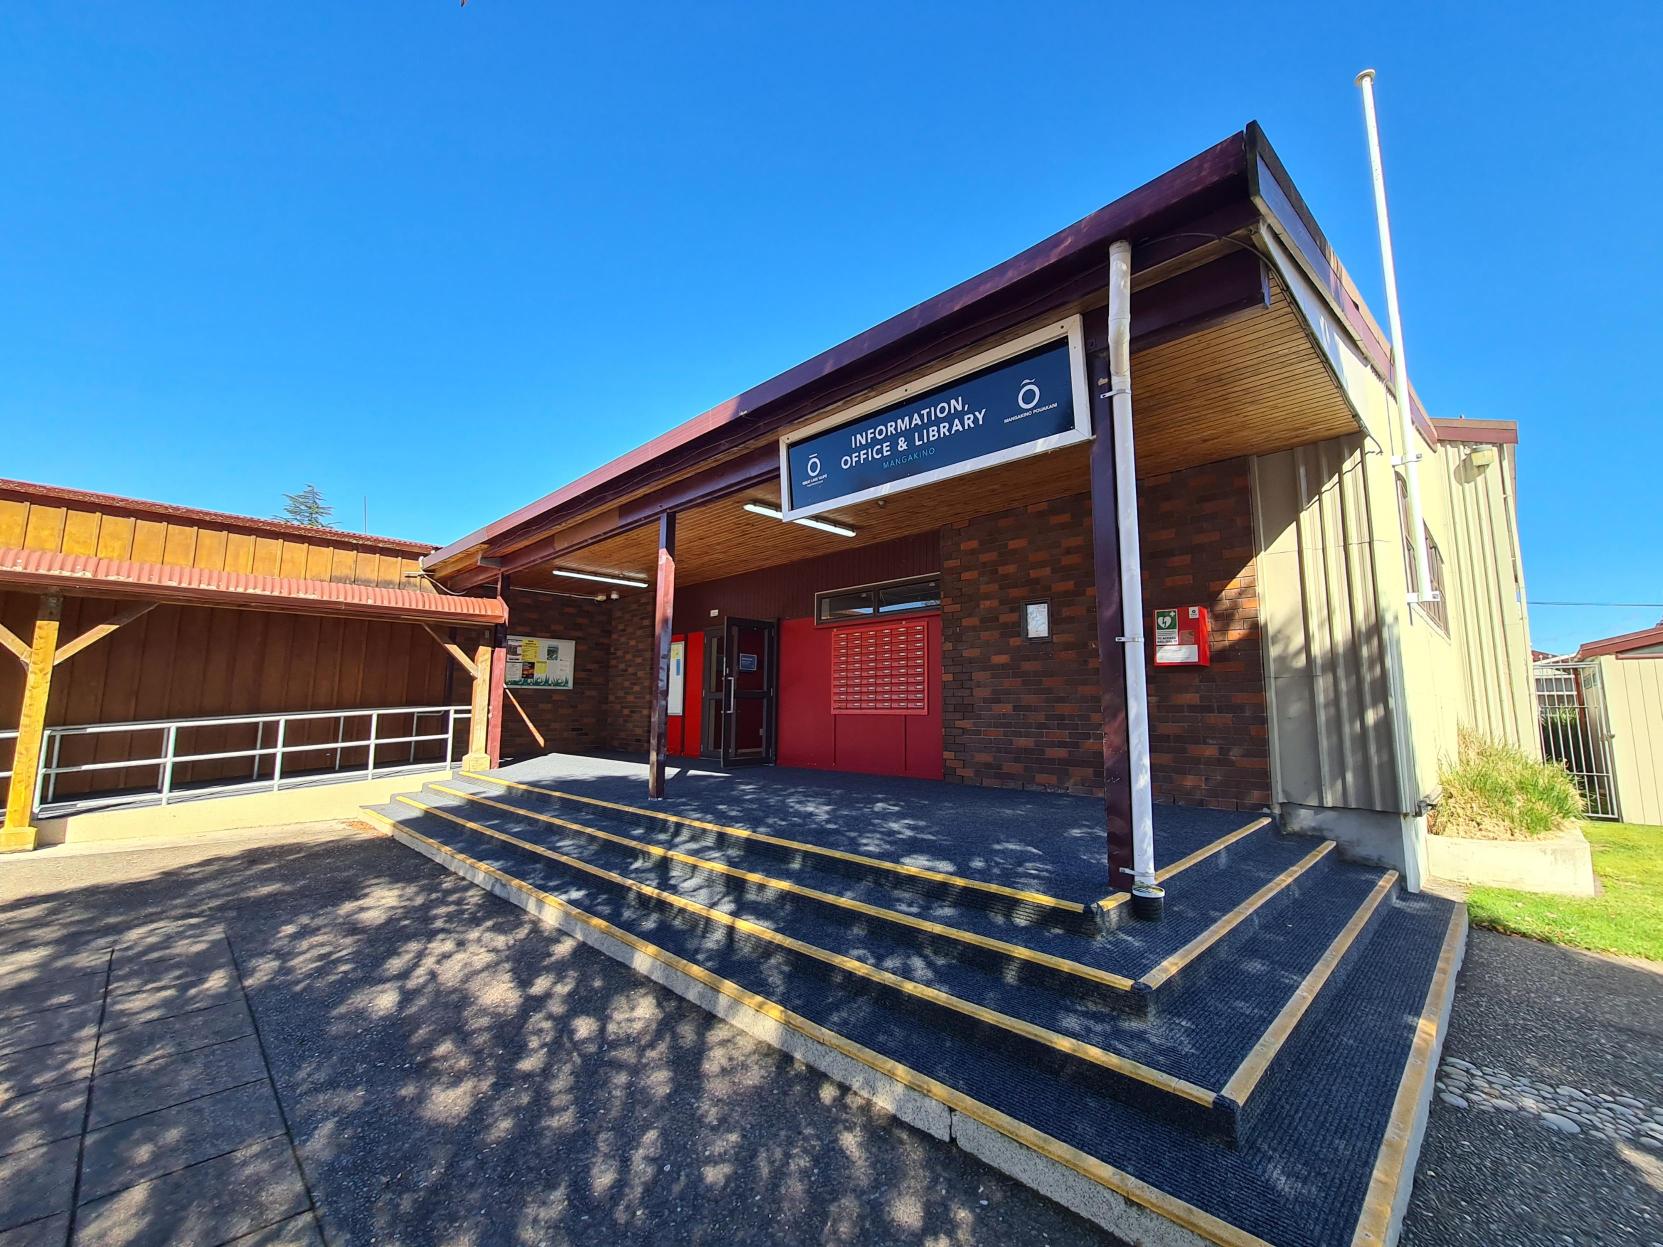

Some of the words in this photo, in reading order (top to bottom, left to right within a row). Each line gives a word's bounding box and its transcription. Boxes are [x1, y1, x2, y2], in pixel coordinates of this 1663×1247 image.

[841, 442, 891, 469] OFFICE
[897, 437, 908, 451] &
[915, 408, 986, 446] LIBRARY
[851, 396, 969, 449] INFORMATION,
[882, 447, 936, 469] MANGAKINO
